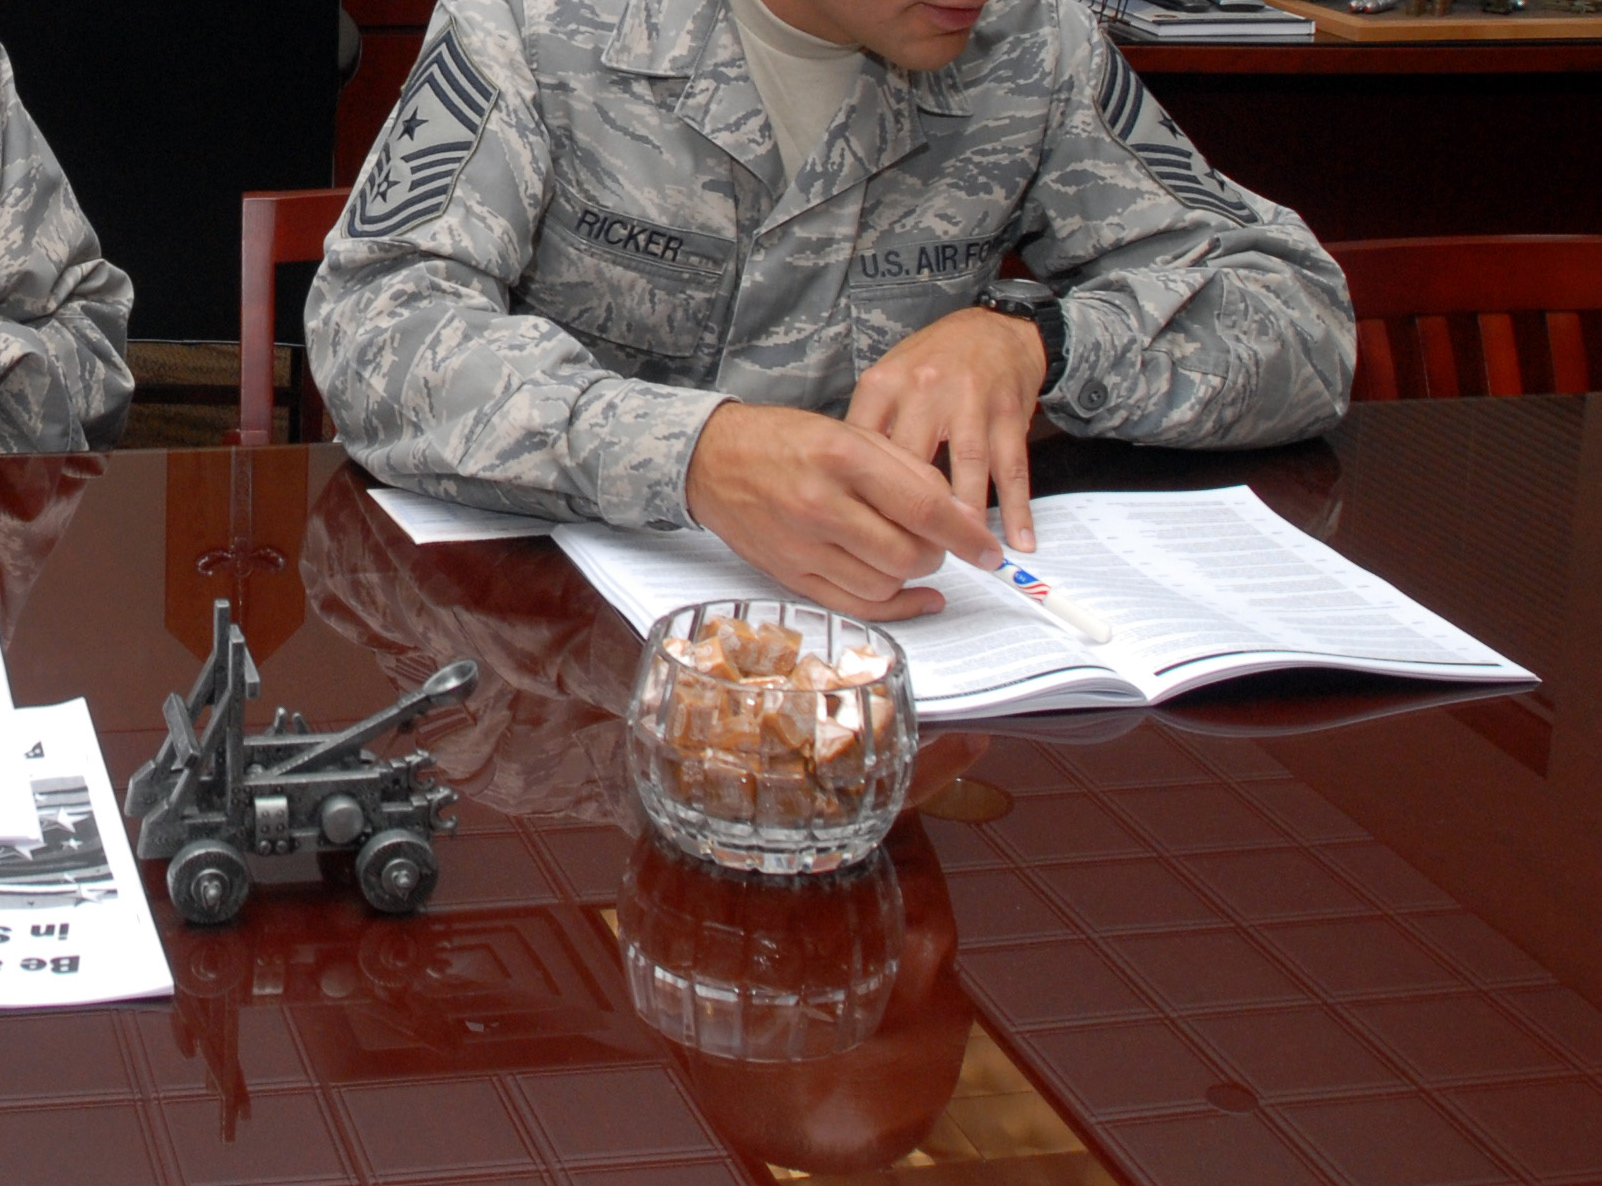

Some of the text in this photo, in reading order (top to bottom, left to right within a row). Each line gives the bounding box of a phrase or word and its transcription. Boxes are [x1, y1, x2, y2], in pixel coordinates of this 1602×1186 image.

[575, 209, 684, 262] RICKER
[860, 250, 911, 279] U.S.
[916, 244, 959, 275] AIR
[30, 922, 70, 941] in
[20, 955, 81, 974] Be
